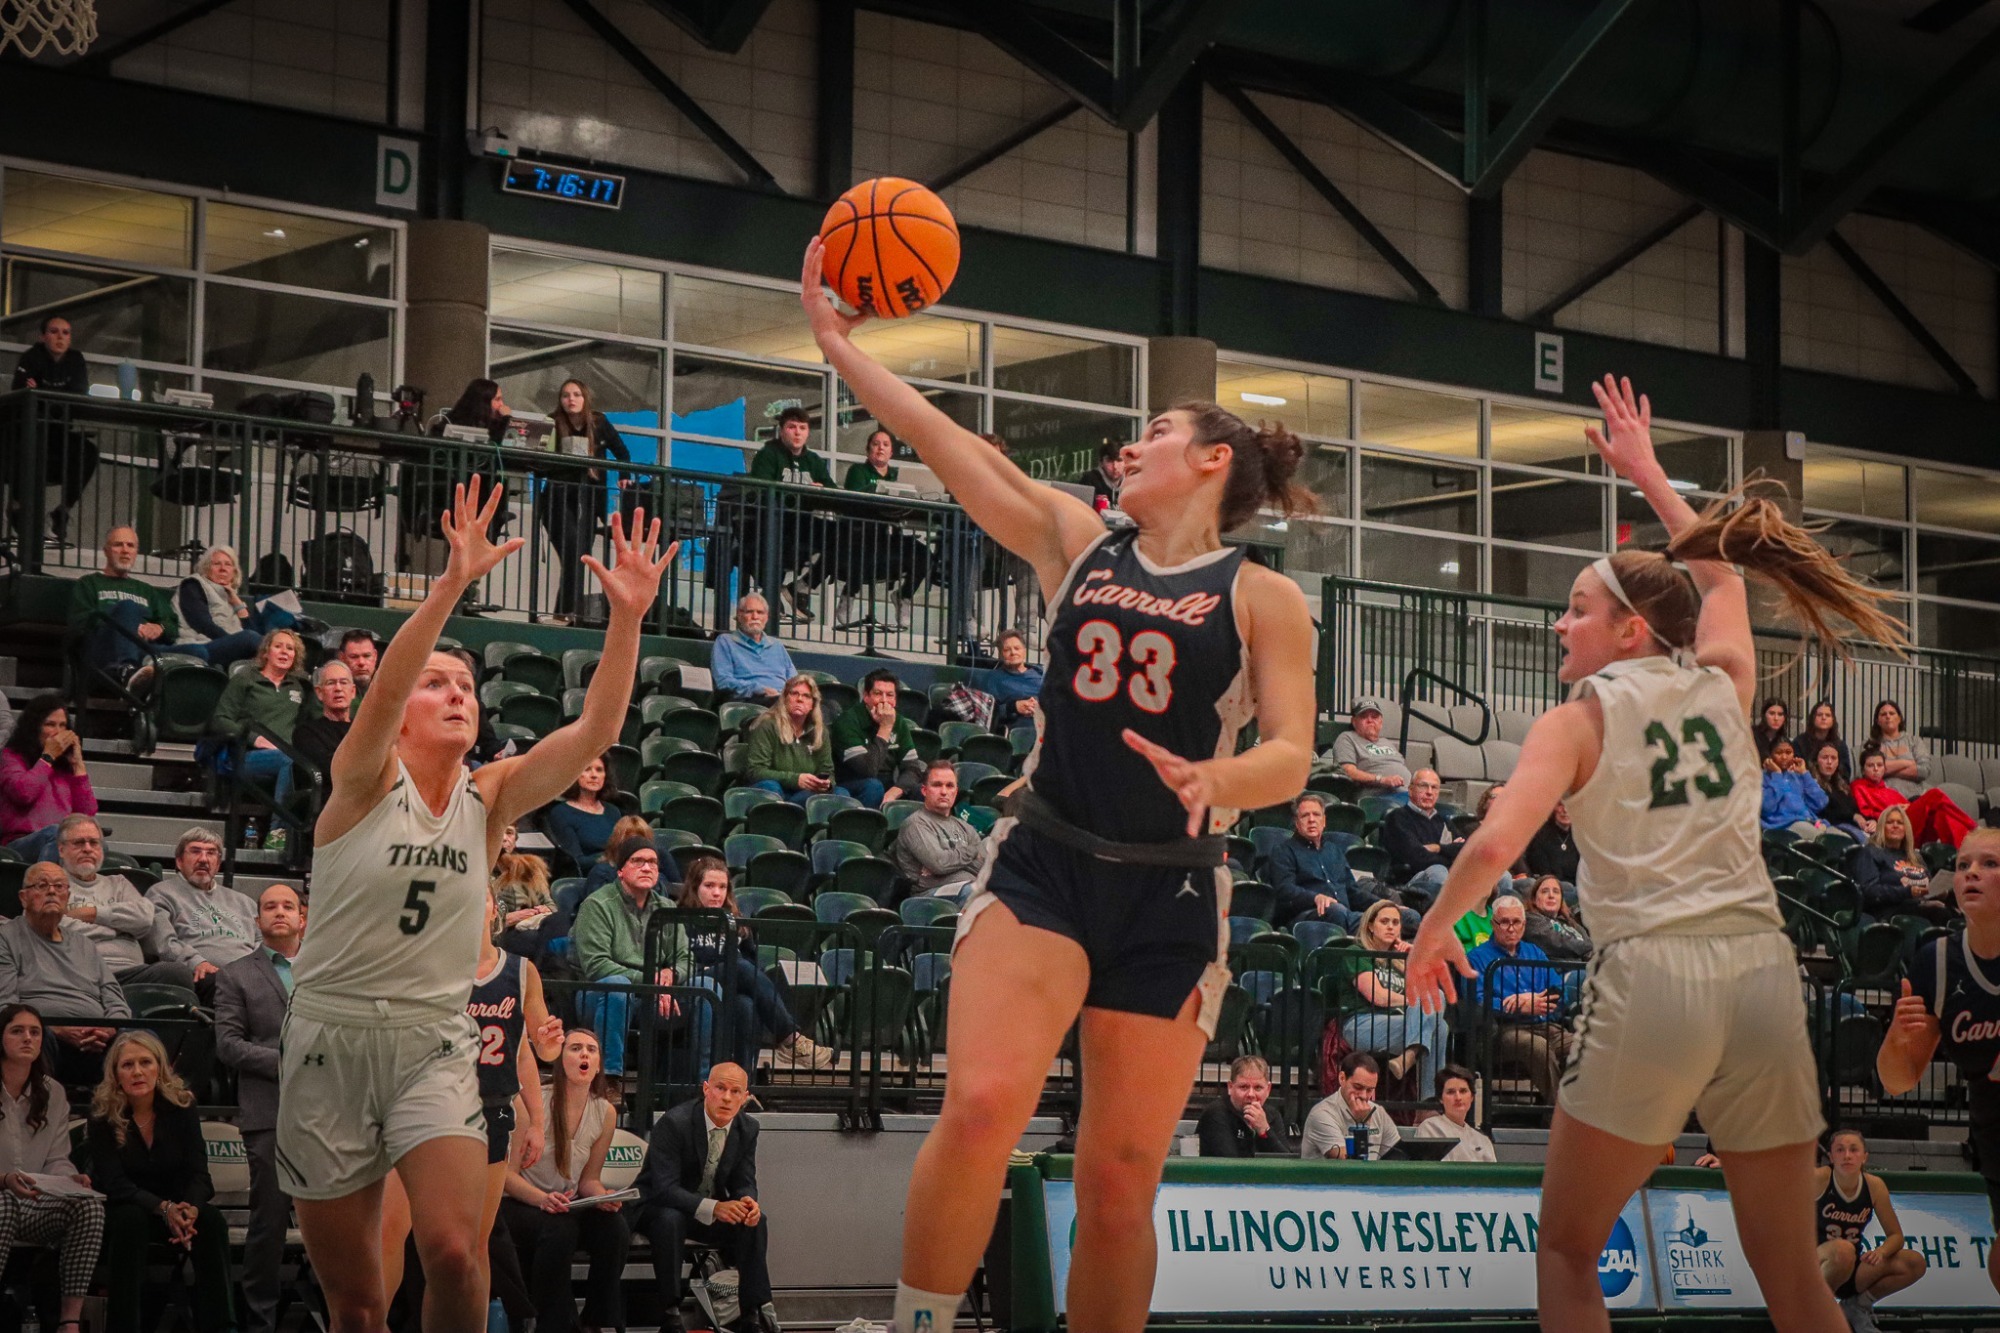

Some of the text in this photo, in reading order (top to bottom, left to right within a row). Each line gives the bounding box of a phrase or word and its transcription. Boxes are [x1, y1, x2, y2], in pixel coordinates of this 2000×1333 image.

[384, 149, 411, 194] D
[534, 168, 615, 202] 7:16:17
[1541, 342, 1558, 381] E
[1030, 449, 1093, 480] DIV. III
[1073, 568, 1221, 626] Carroll
[1073, 619, 1178, 715] 33
[1644, 715, 1735, 809] 23
[386, 844, 467, 874] TITANS
[399, 880, 436, 935] 5
[466, 996, 516, 1019] rroll
[480, 1025, 505, 1066] 2
[206, 1141, 247, 1156] ITANS
[605, 1147, 643, 1161] TANS
[1822, 1203, 1871, 1223] Carroll
[1167, 1209, 1340, 1253] ILLINOIS
[1598, 1249, 1638, 1273] CAA
[1670, 1249, 1724, 1269] SHIRK
[1269, 1266, 1472, 1290] UNIVERSITY
